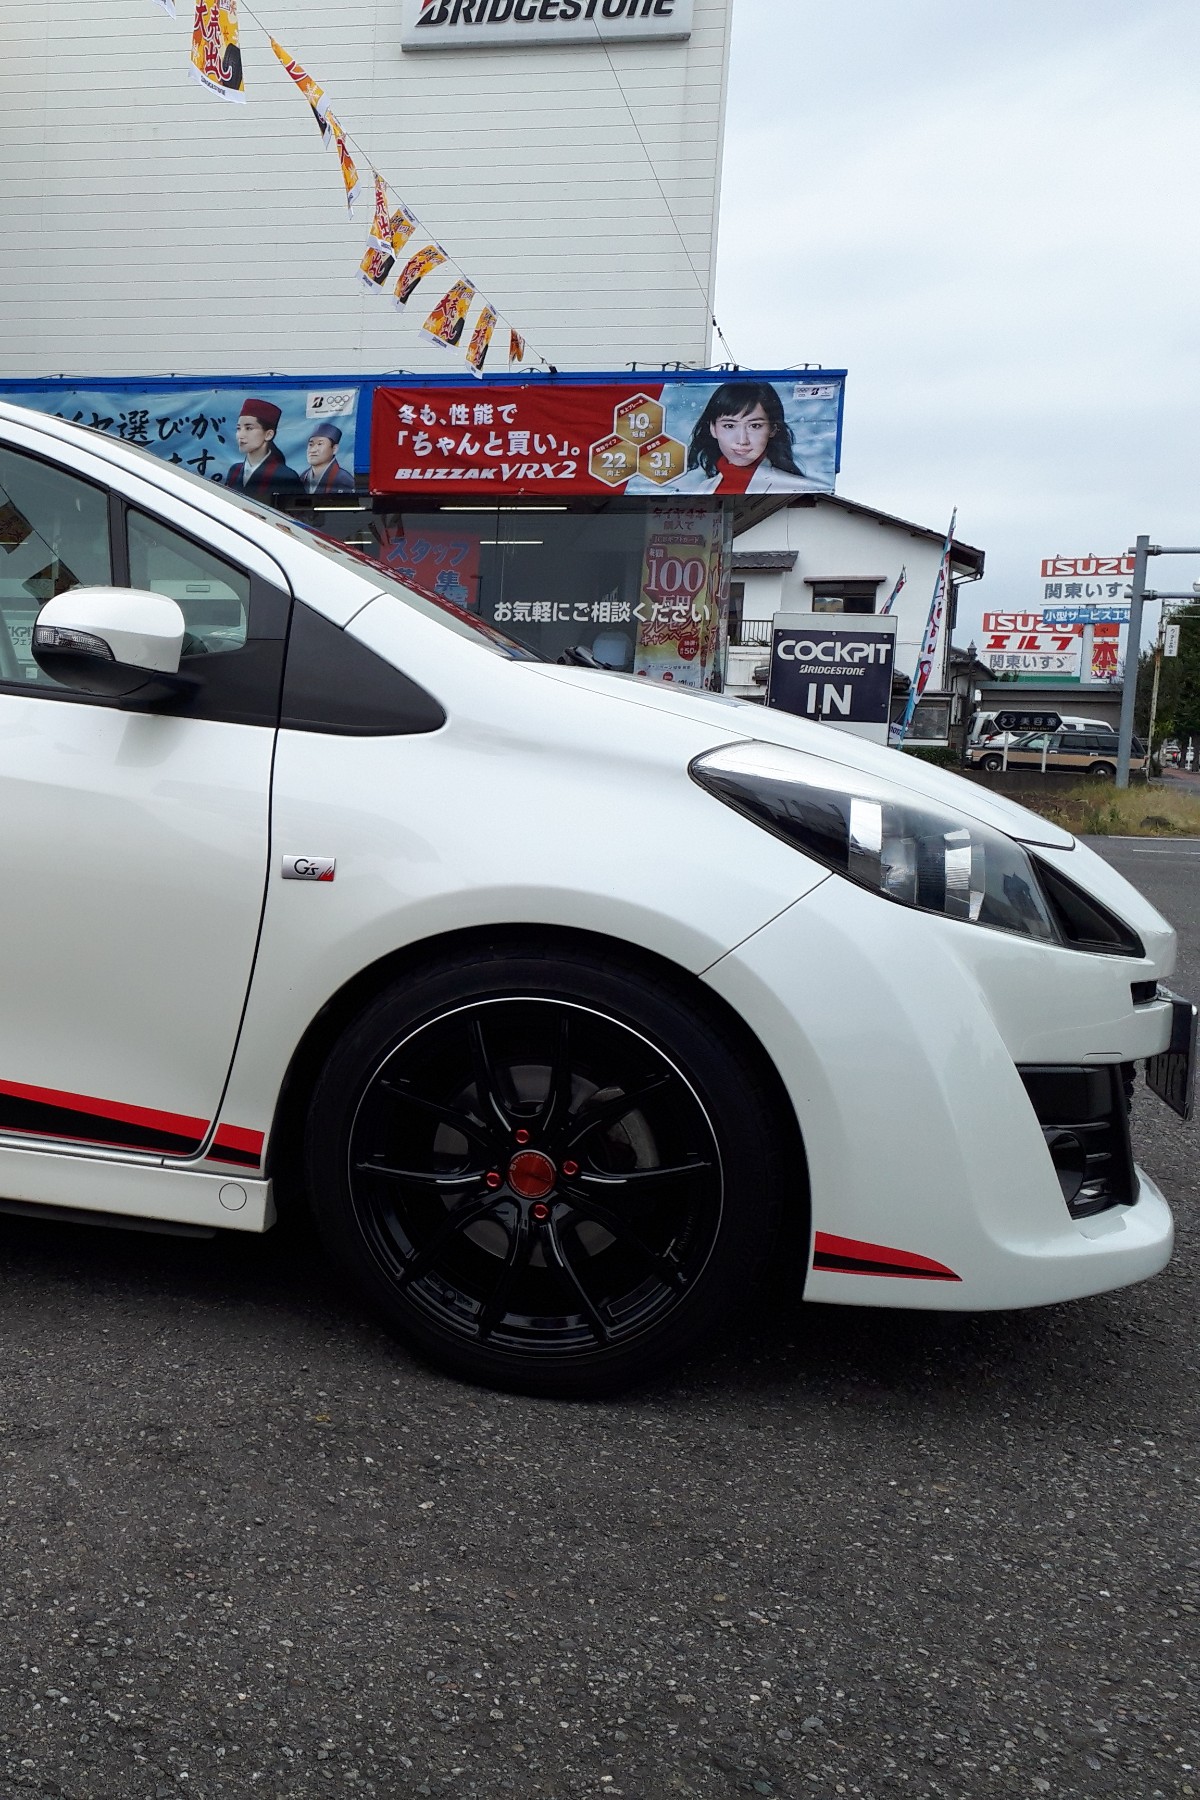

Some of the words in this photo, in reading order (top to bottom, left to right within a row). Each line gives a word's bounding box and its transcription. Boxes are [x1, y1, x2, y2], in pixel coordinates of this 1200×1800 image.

[398, 403, 518, 426] 冬も、性能で
[394, 468, 499, 480] BLIZZAK
[500, 460, 577, 481] VRX2
[647, 560, 704, 592] 100
[1044, 582, 1133, 599] 関東いす
[493, 601, 710, 622] お気軽にご相談ください
[777, 640, 891, 664] COCKPIT
[987, 635, 1074, 650] エルフ
[799, 664, 866, 676] BRIDGESTONE
[806, 683, 853, 715] IN
